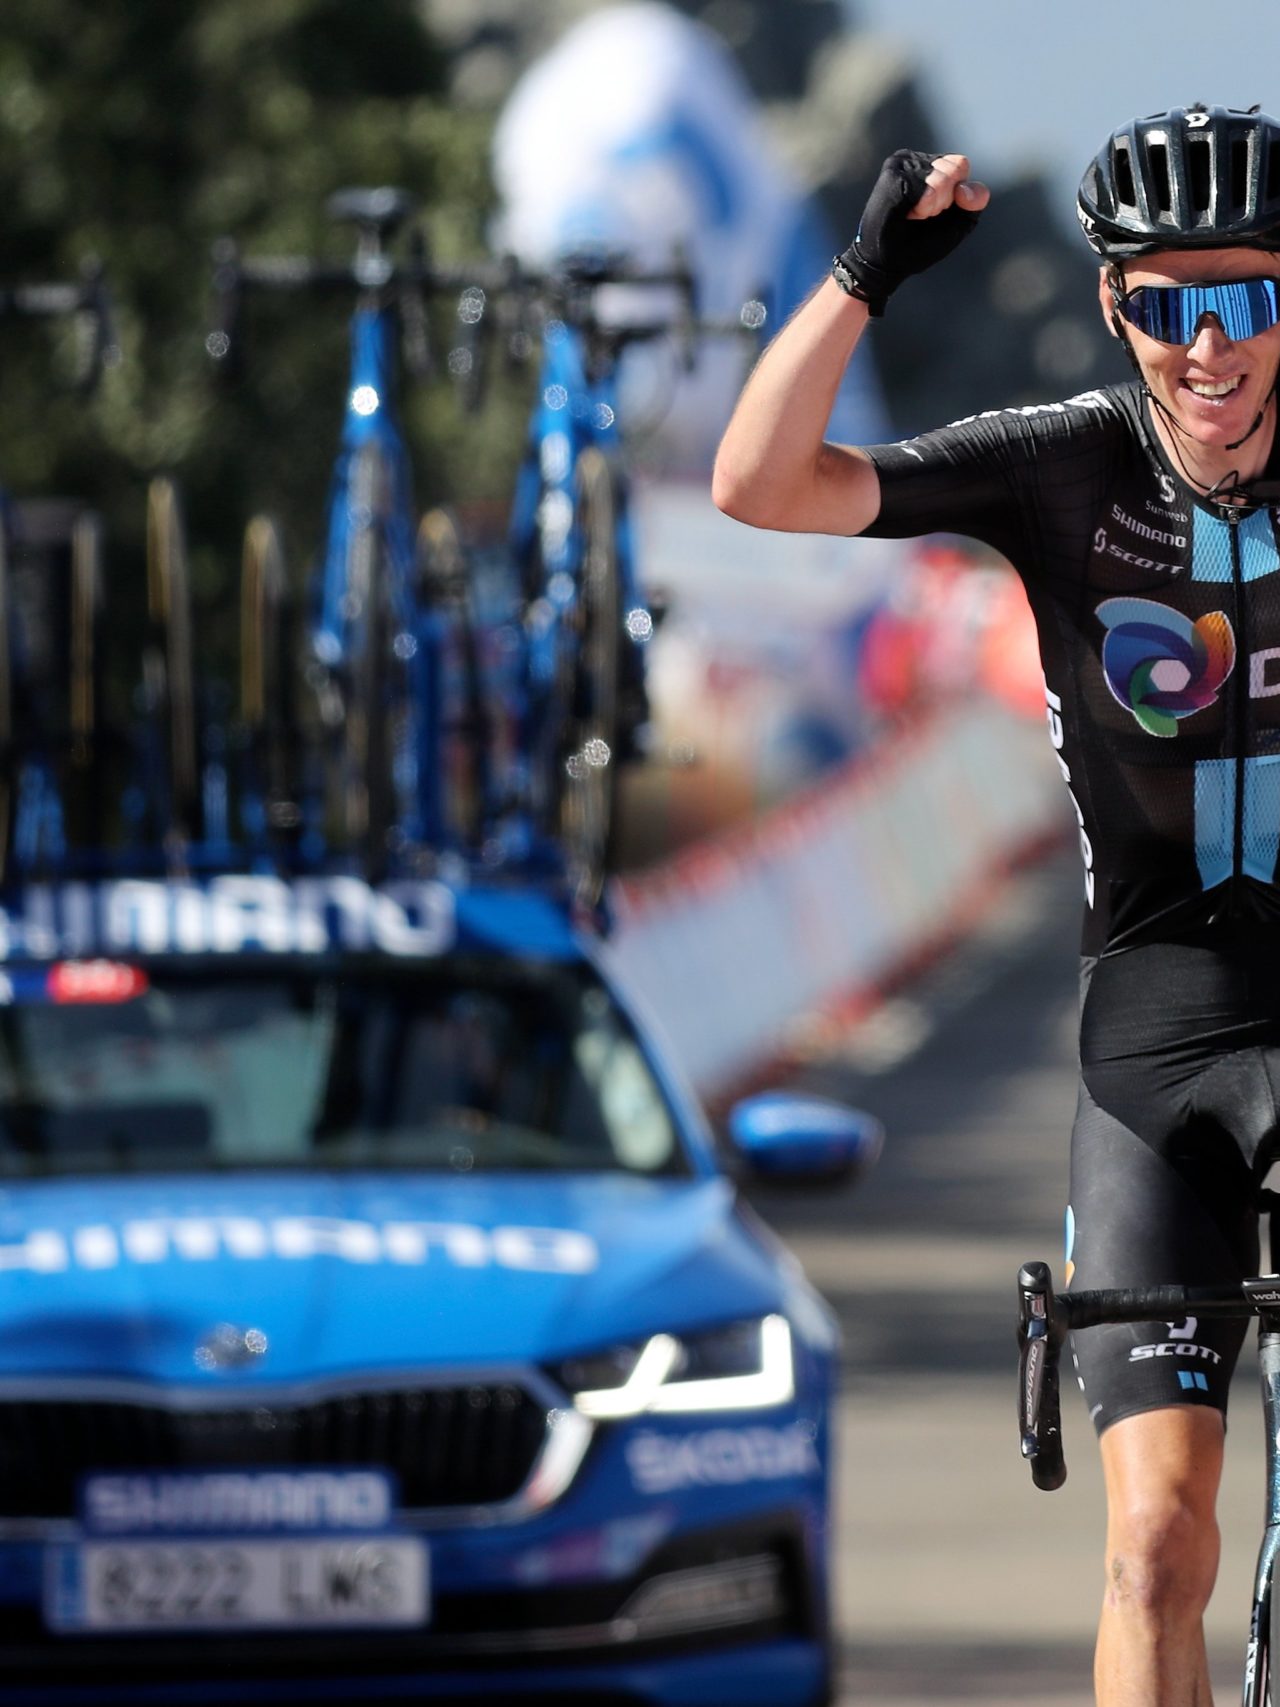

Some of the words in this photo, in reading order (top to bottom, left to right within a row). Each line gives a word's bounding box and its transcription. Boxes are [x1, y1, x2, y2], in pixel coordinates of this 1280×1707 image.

[1111, 503, 1187, 548] SHIMANO
[1145, 500, 1188, 523] Sunweb
[1106, 543, 1185, 575] SCOTT
[1128, 1343, 1222, 1366] SCOTT
[86, 1472, 389, 1531] SHIMANO
